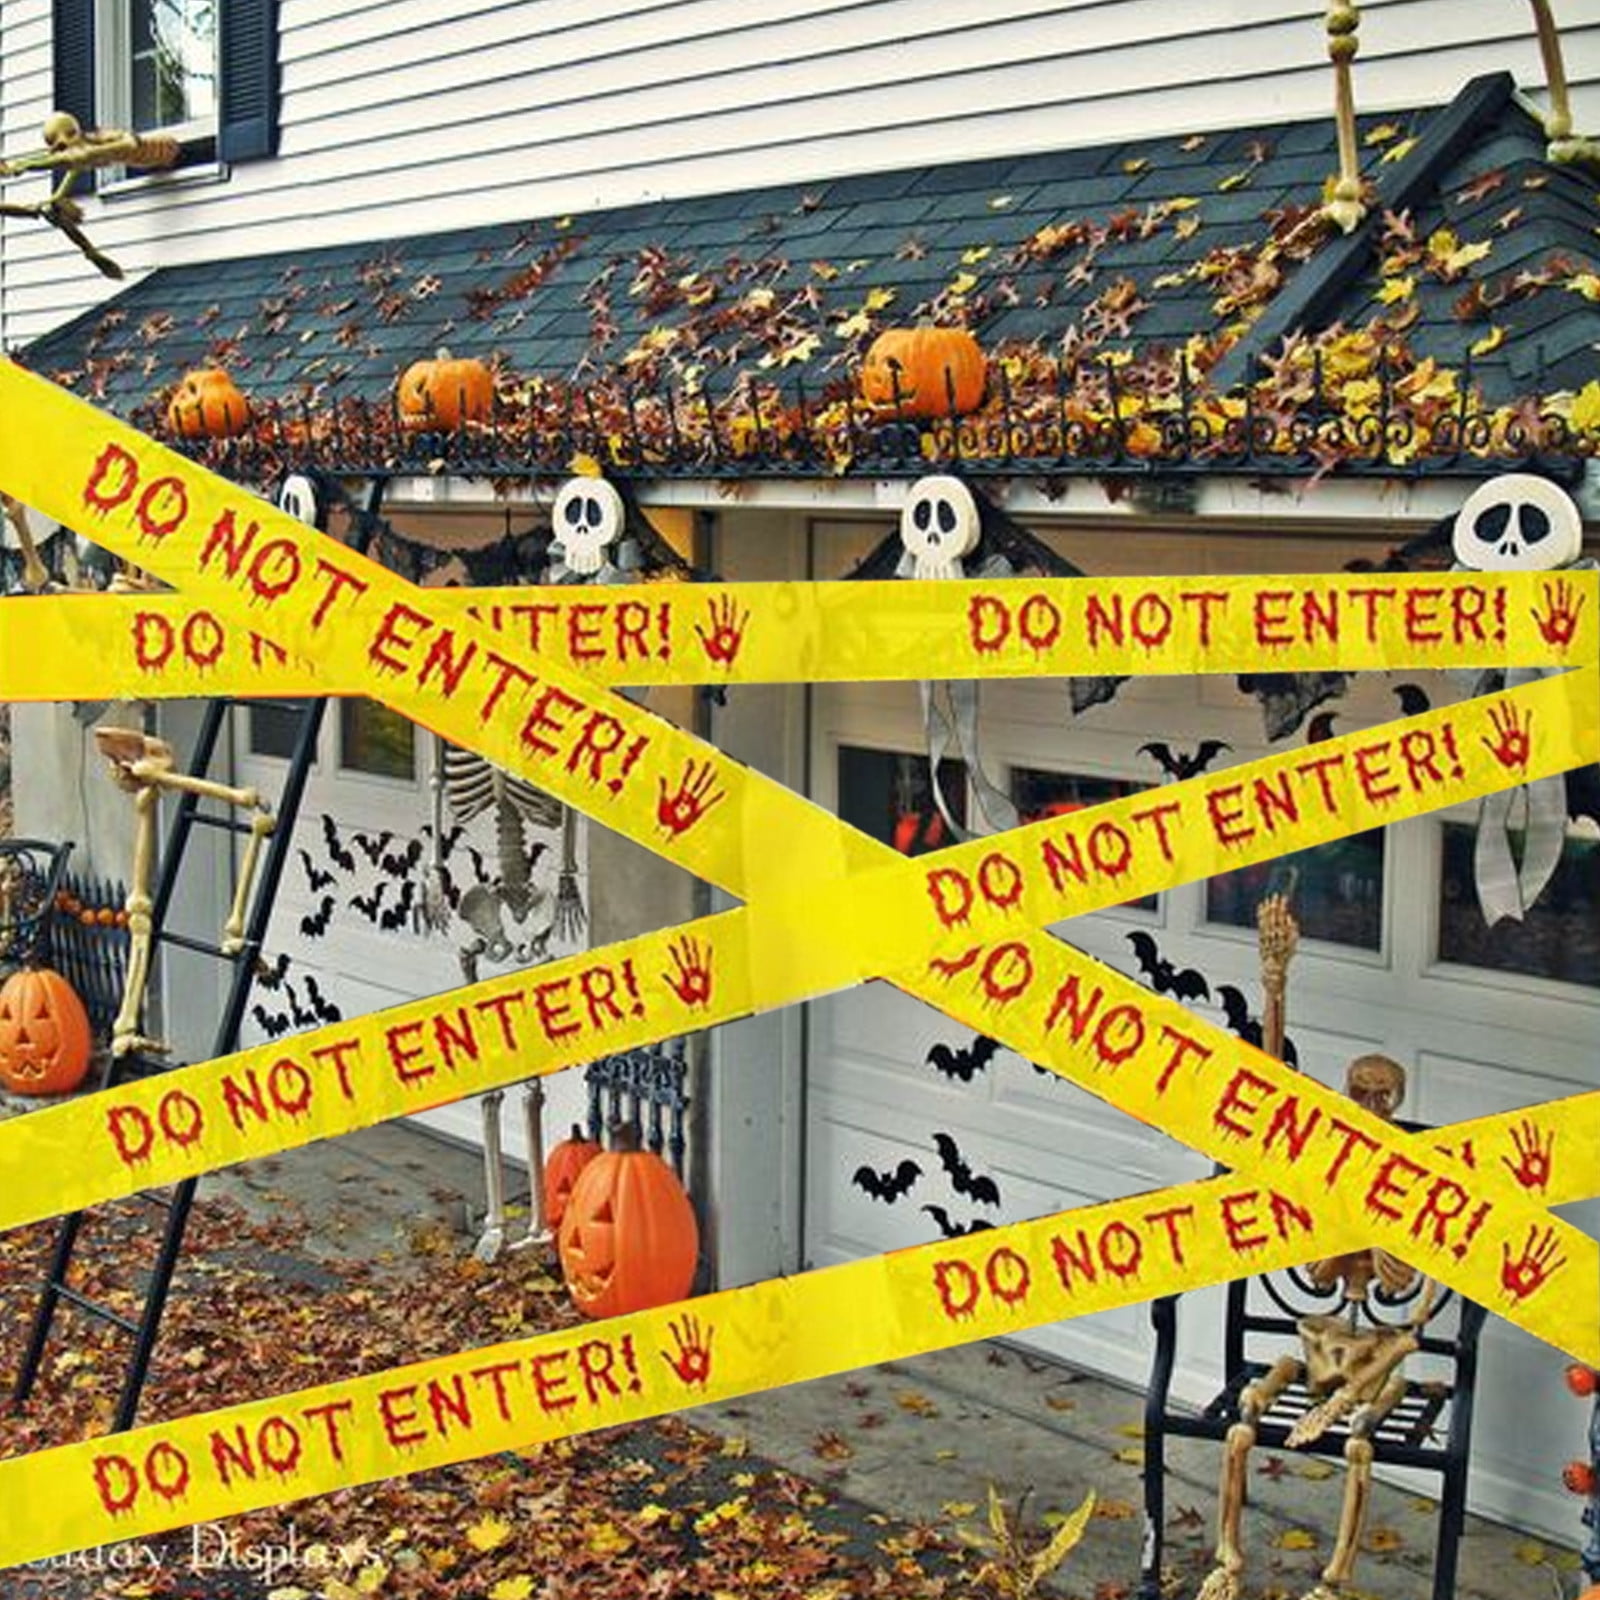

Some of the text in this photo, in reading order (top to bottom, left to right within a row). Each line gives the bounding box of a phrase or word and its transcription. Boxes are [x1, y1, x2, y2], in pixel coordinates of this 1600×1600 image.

[83, 443, 649, 797] DO NOT ENTER!
[132, 610, 224, 674] DO
[968, 588, 1506, 657] DO NOT ENTER!
[926, 722, 1466, 930] DO NOT ENTER!
[106, 958, 645, 1168] DO NOT ENTER!
[1044, 975, 1212, 1097] NOT
[1212, 1067, 1491, 1262] ENTER!
[933, 1246, 1031, 1322] DO
[1051, 1205, 1194, 1292] NOT
[92, 1333, 642, 1517] DO NOT ENTER!
